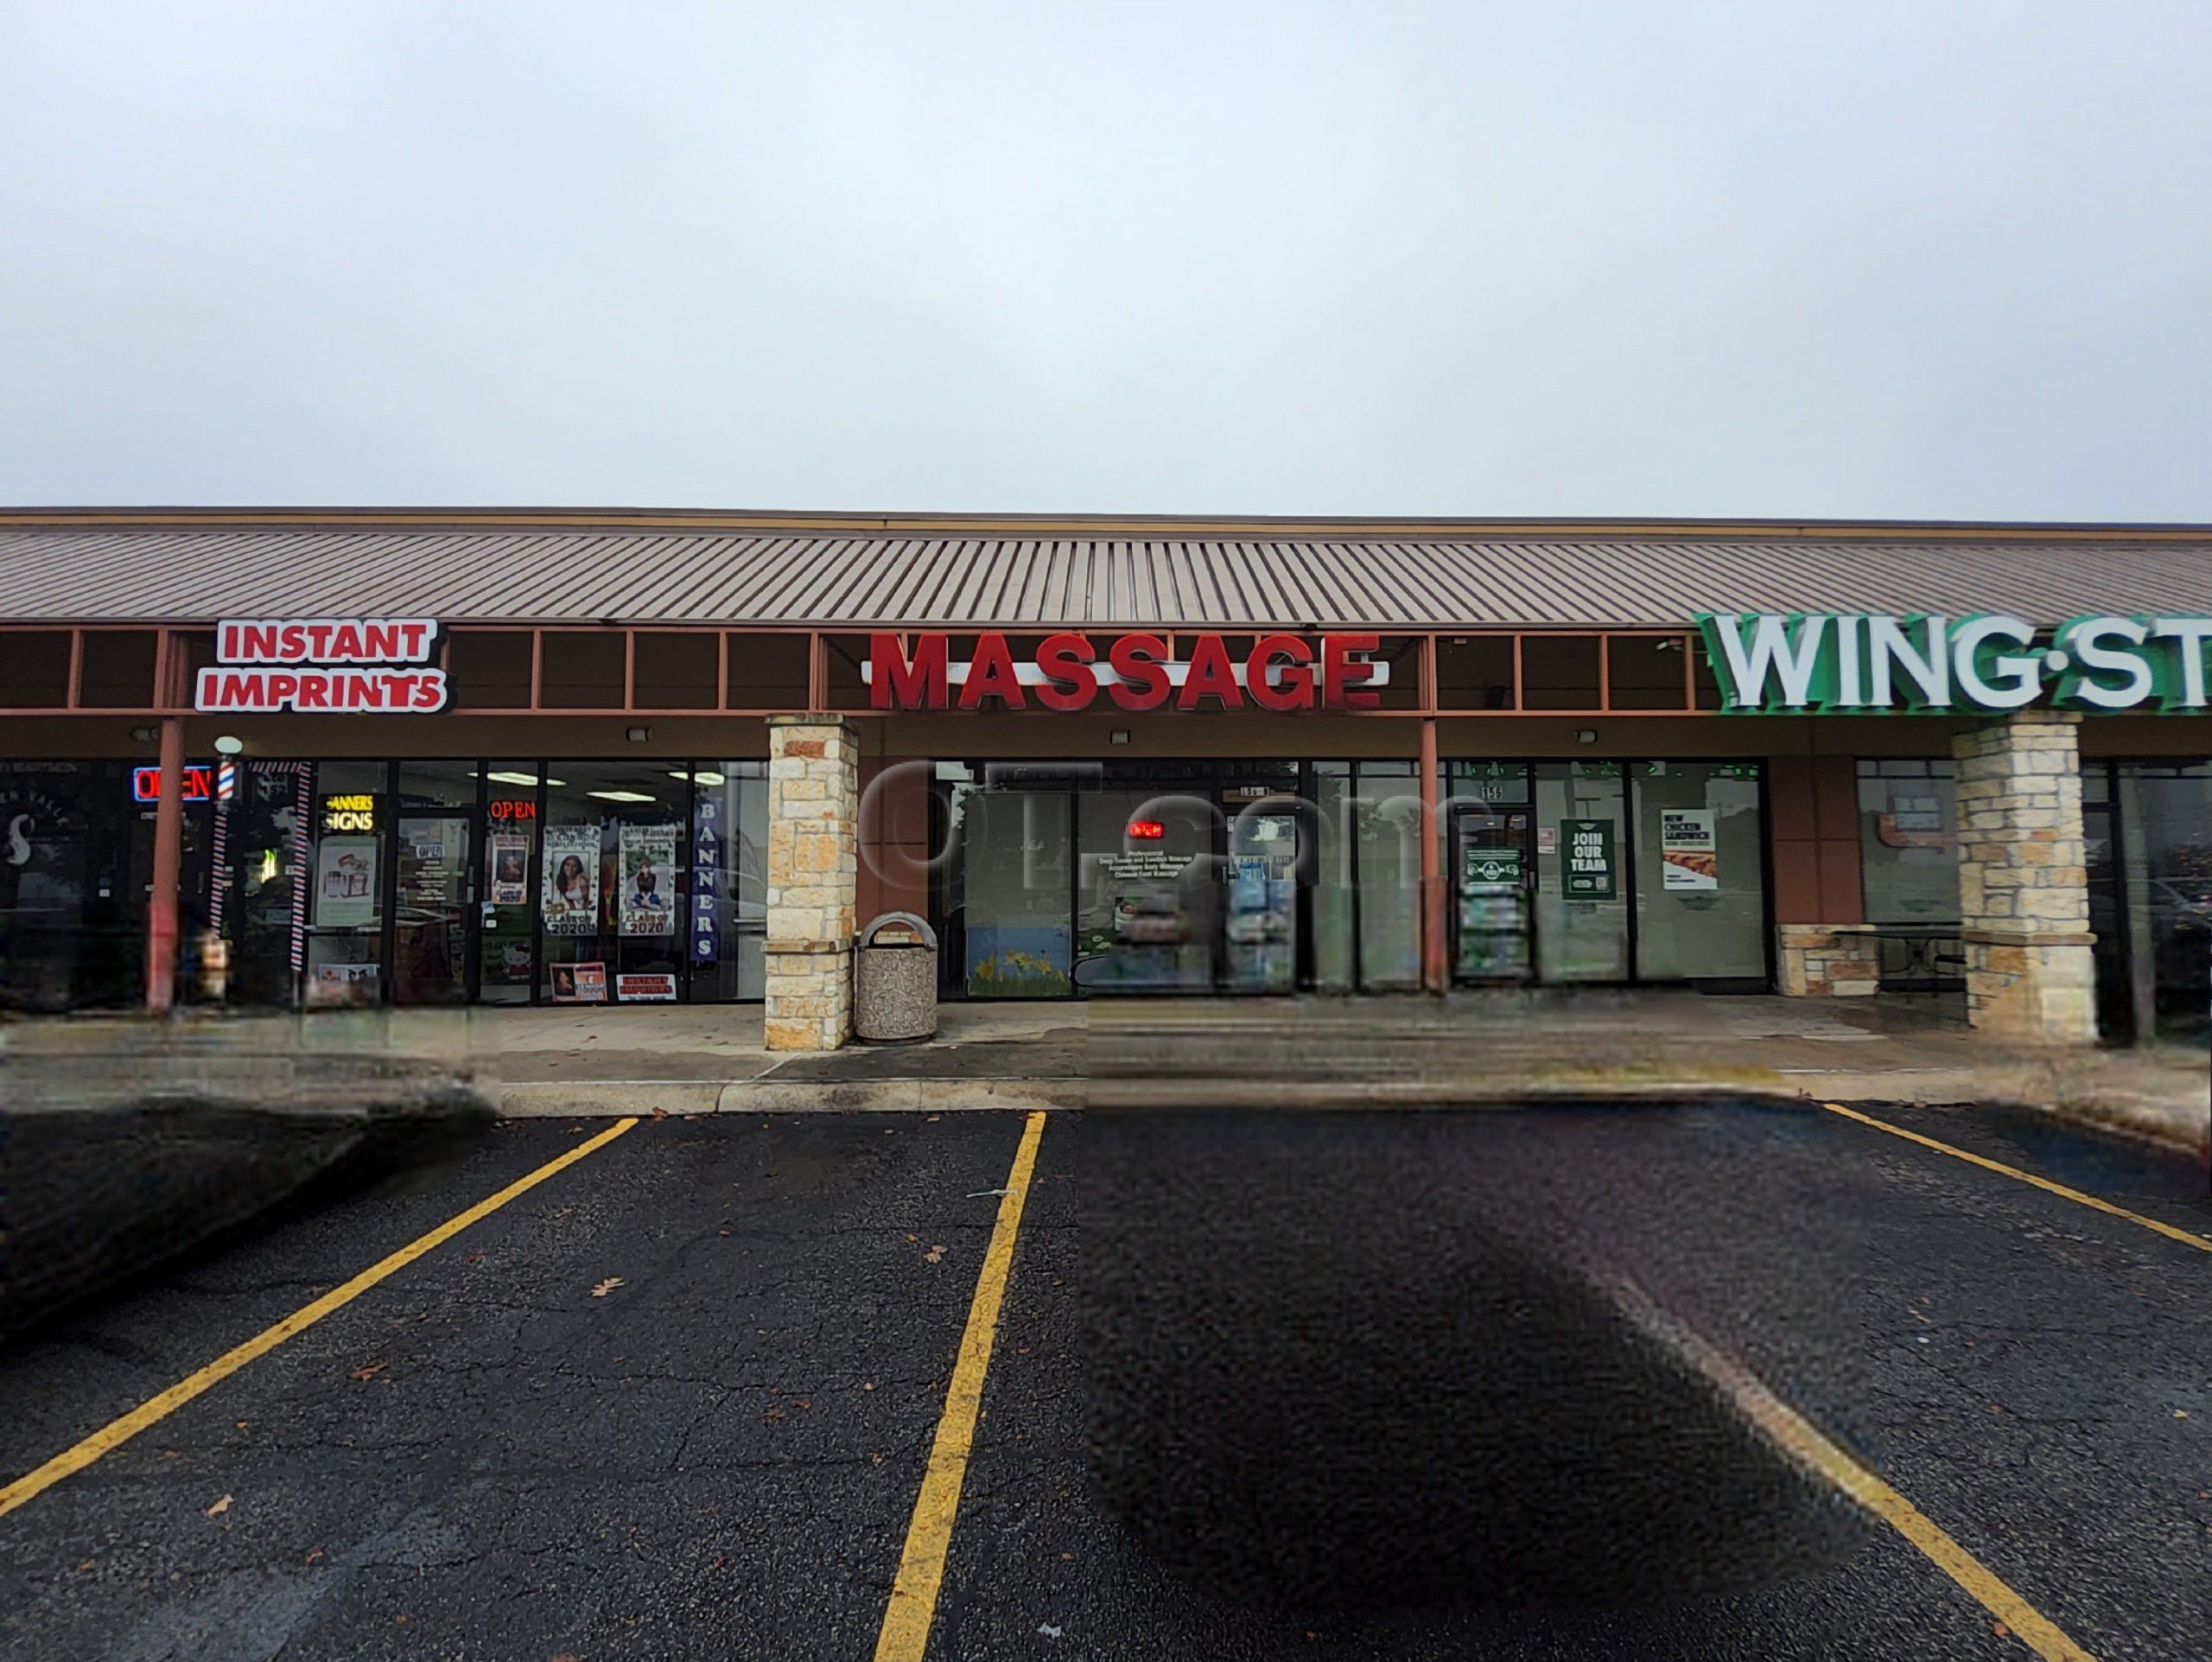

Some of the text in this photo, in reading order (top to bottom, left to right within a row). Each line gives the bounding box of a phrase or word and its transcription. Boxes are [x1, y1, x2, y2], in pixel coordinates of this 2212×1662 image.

[223, 624, 428, 659] INSTANT
[870, 633, 1381, 711] MASSAGE
[201, 673, 442, 709] IMPRINTS
[137, 770, 212, 799] OEN
[490, 800, 536, 819] OPEN
[325, 812, 374, 831] SIGNS
[1572, 832, 1603, 845] JOIN
[1573, 845, 1603, 858] OUR
[1570, 858, 1607, 872] TEAM
[698, 804, 716, 956] BANNERS
[551, 923, 587, 934] 2020
[630, 922, 664, 933] 2020
